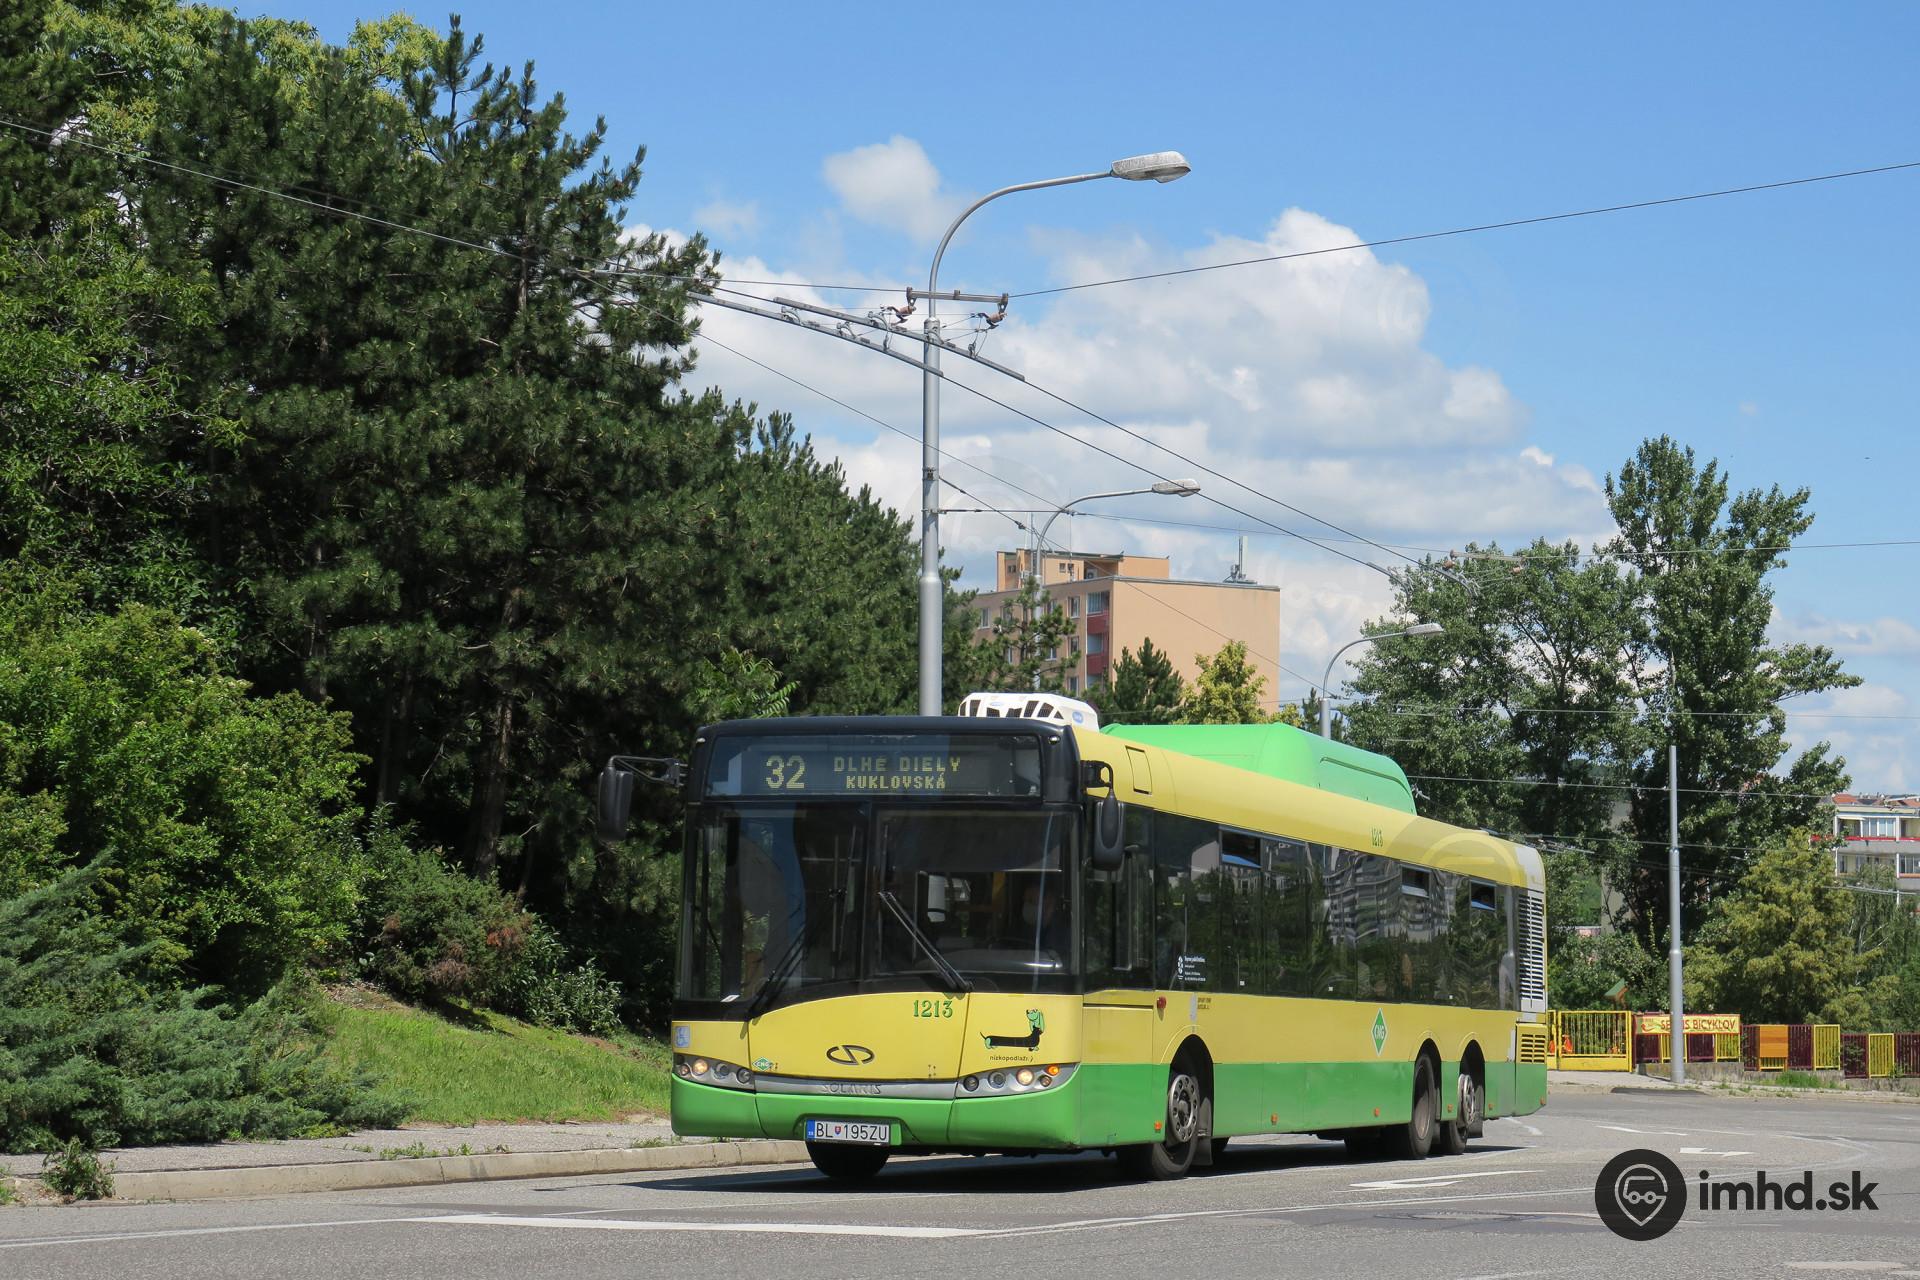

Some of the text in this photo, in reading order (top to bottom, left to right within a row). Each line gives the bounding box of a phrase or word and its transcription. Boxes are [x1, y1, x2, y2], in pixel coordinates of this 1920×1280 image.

[766, 755, 807, 789] 32
[833, 756, 961, 772] DLHÉ DIELY
[846, 772, 946, 789] KUKLOVSKÁ
[913, 1000, 953, 1018] 1213
[1373, 1024, 1386, 1040] CNG
[1660, 1019, 1736, 1030] SEIS BICYKLOV
[820, 1082, 882, 1095] SOLARIS
[816, 1122, 888, 1141] BL 195ZU
